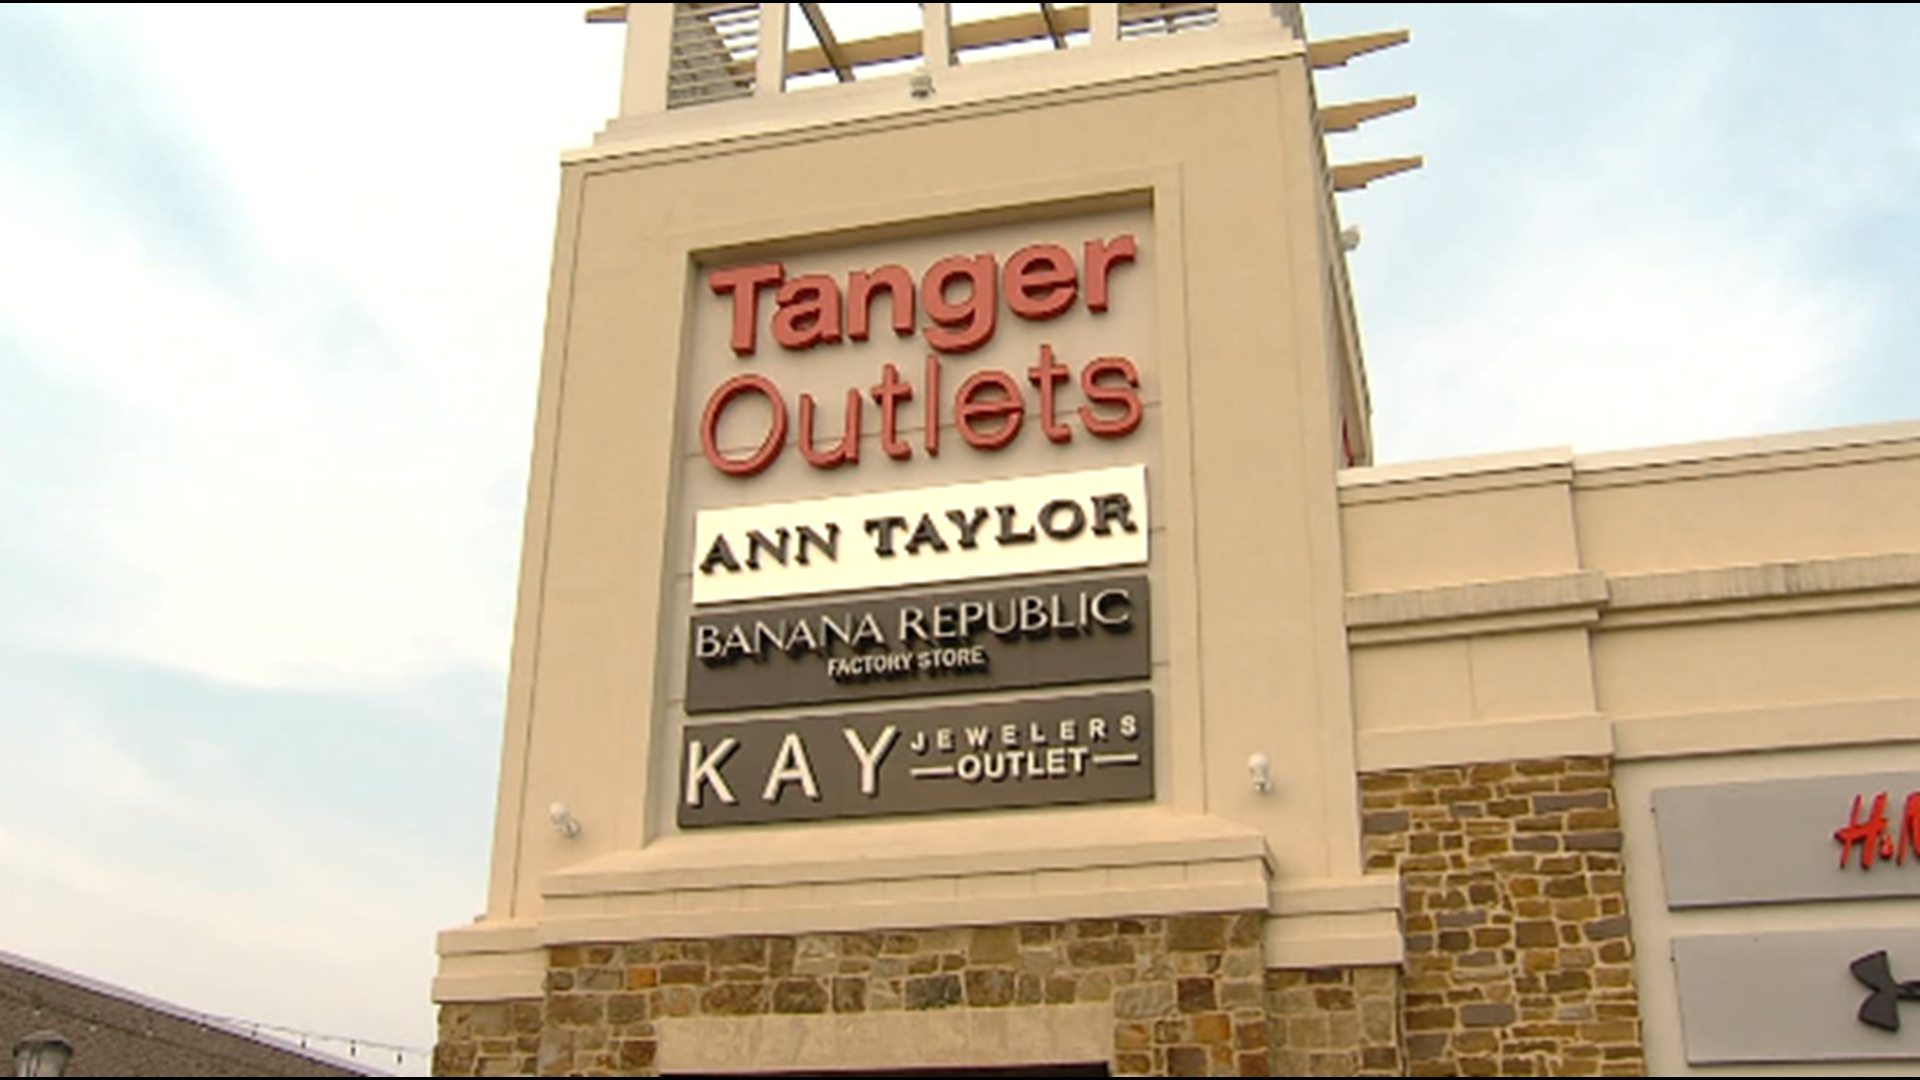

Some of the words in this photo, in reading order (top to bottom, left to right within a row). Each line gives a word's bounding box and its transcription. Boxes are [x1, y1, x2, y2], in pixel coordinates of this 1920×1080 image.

[708, 234, 1137, 356] Tanger
[701, 344, 1143, 477] Outlets
[699, 522, 841, 574] ANN
[864, 493, 1138, 558] TAYLOR
[695, 612, 884, 659] BANANA
[898, 588, 1131, 641] REPUBLIC
[827, 650, 913, 677] FACTORY
[917, 645, 985, 669] STORE
[685, 725, 897, 806] KAY
[910, 715, 1137, 752] JEWELERS
[957, 746, 1090, 781] OUTLET
